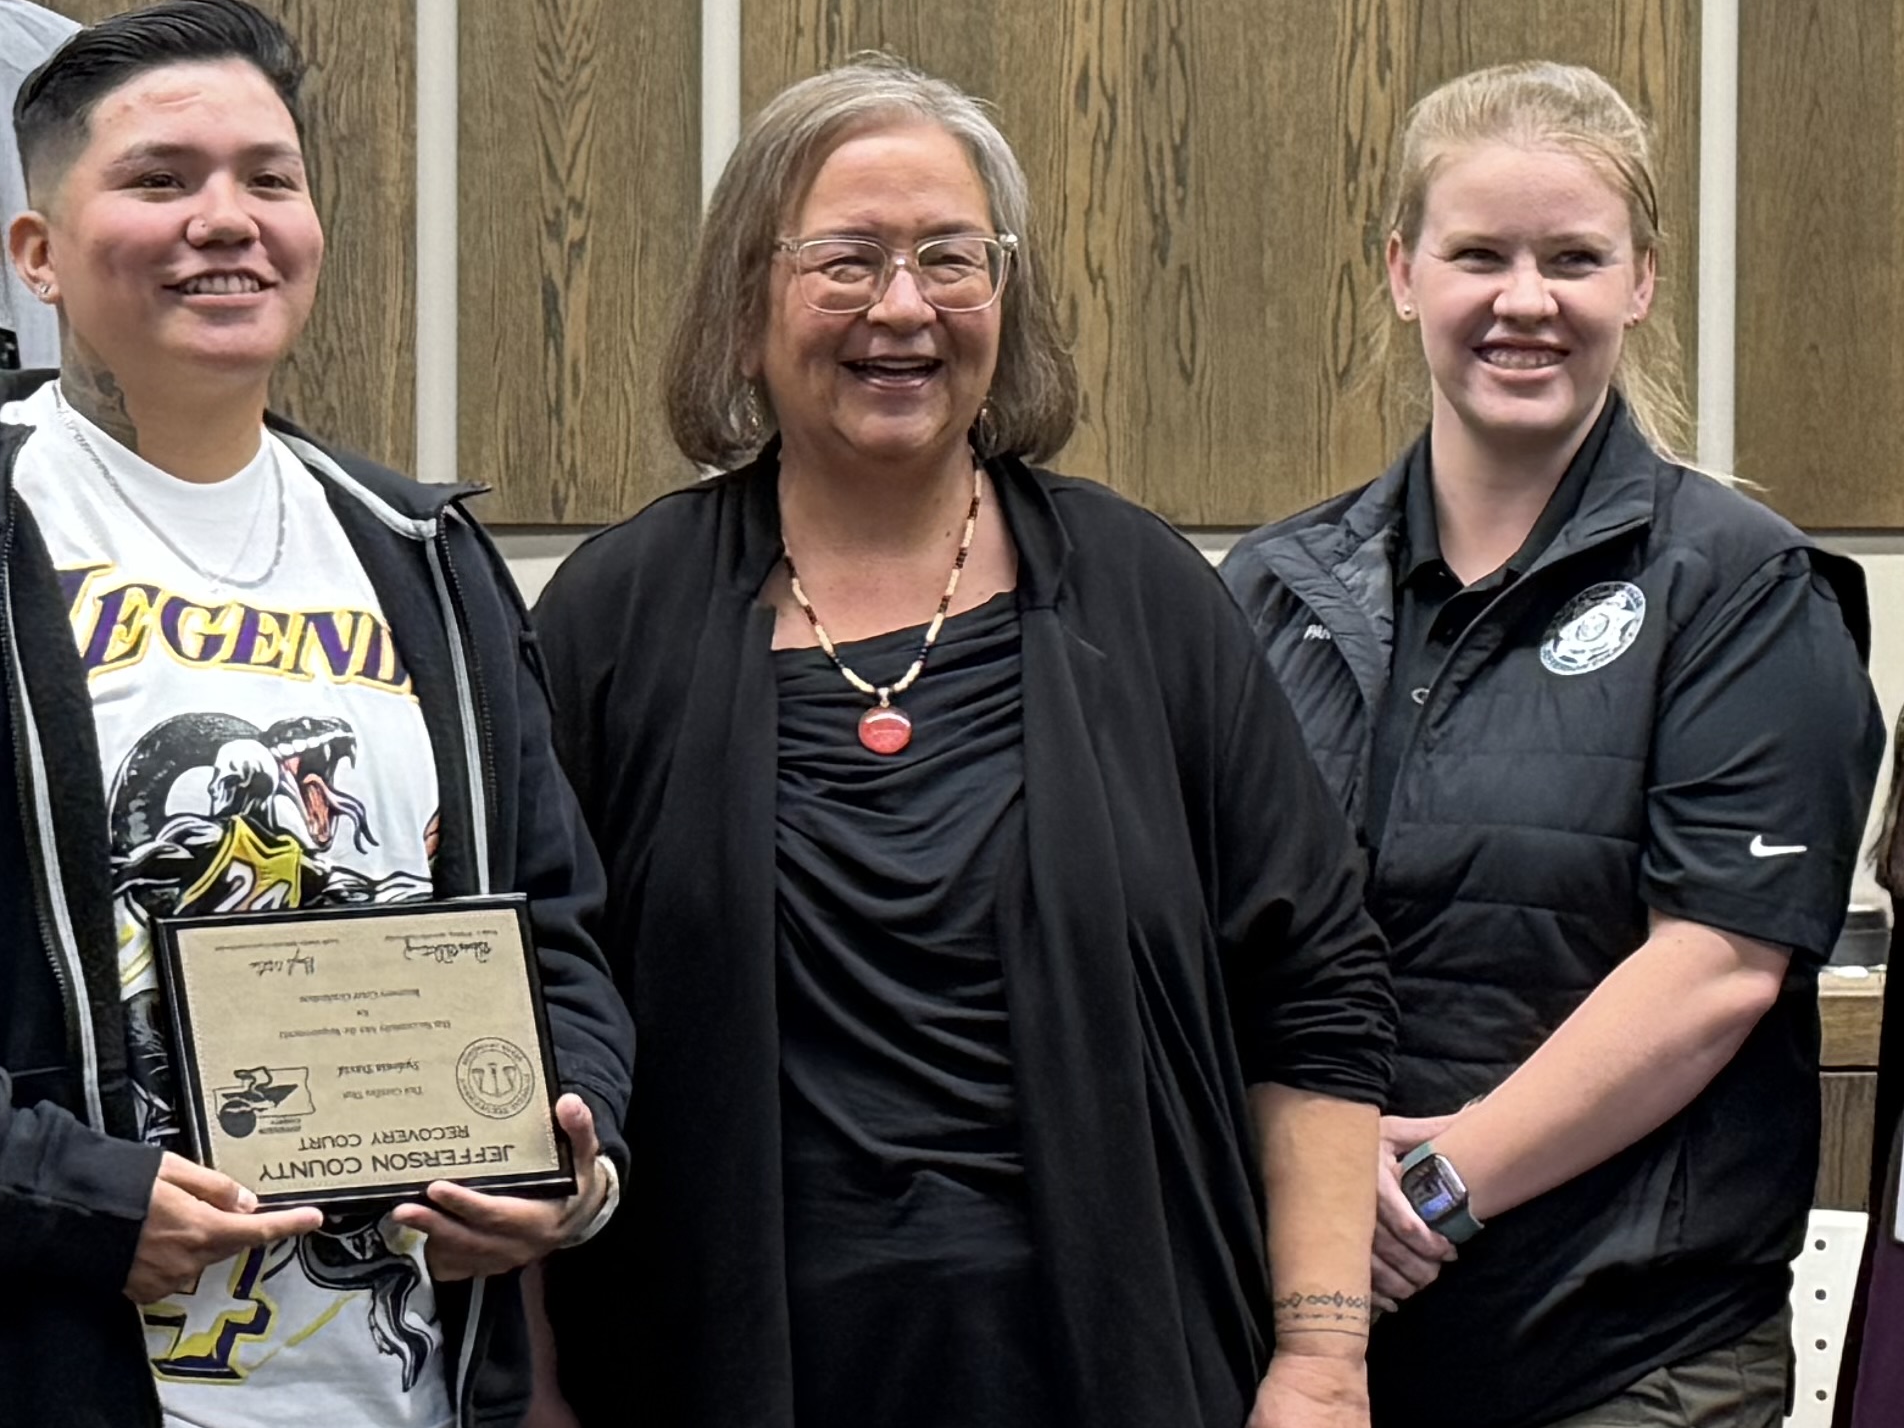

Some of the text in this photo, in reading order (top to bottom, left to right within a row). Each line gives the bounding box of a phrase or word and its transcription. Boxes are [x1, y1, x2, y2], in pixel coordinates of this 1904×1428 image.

[298, 1124, 470, 1152] RECOVERY COURT
[259, 1144, 516, 1182] JEFFERSON COUNTY
